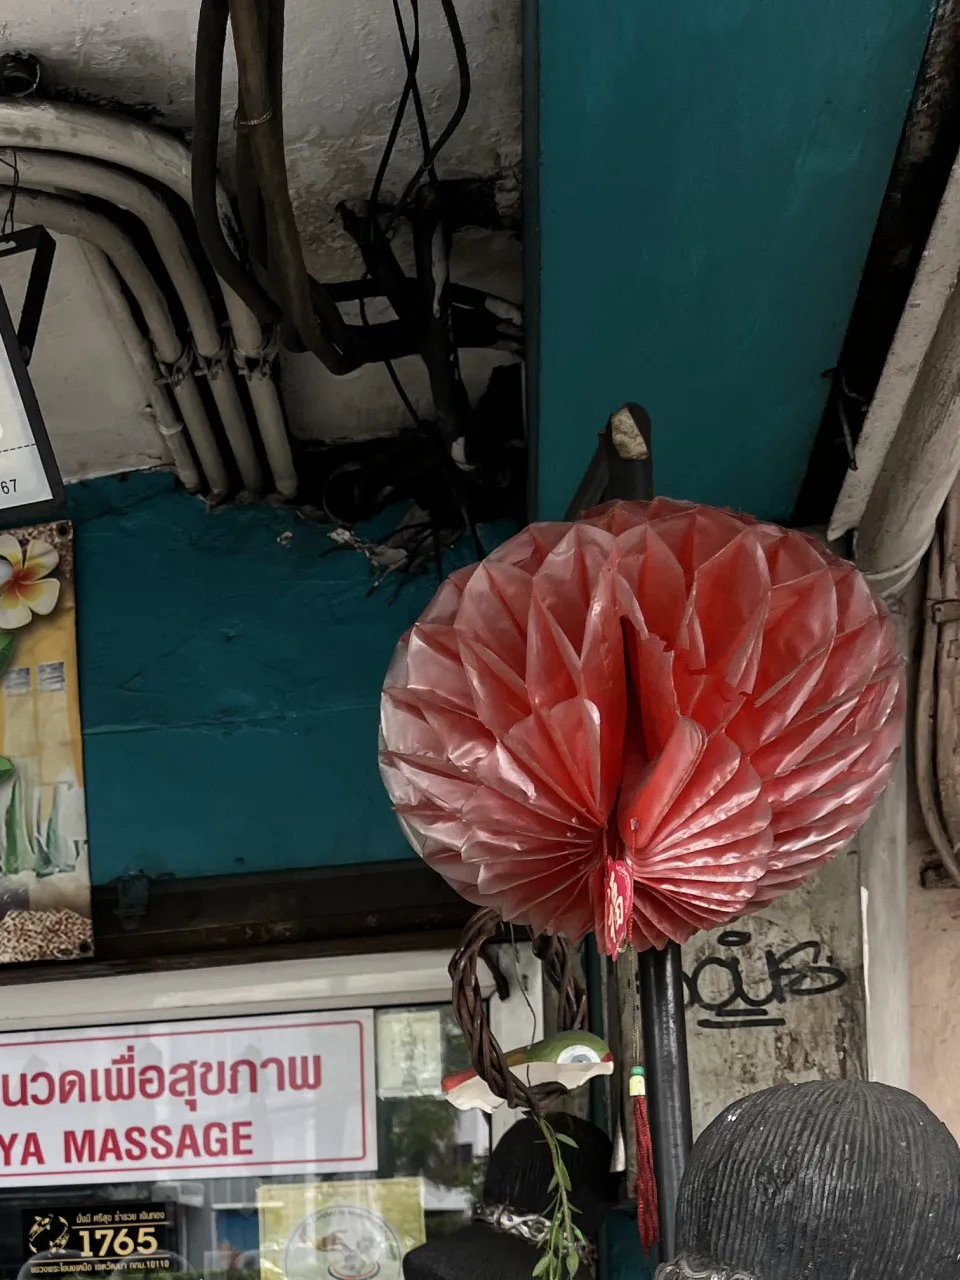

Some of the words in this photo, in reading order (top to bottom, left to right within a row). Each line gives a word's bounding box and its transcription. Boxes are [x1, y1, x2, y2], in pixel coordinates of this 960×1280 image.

[1, 1045, 322, 1112] นวดเพื่อสุขภาพ
[64, 1120, 253, 1166] MASSAGE
[79, 1227, 159, 1258] 1765
